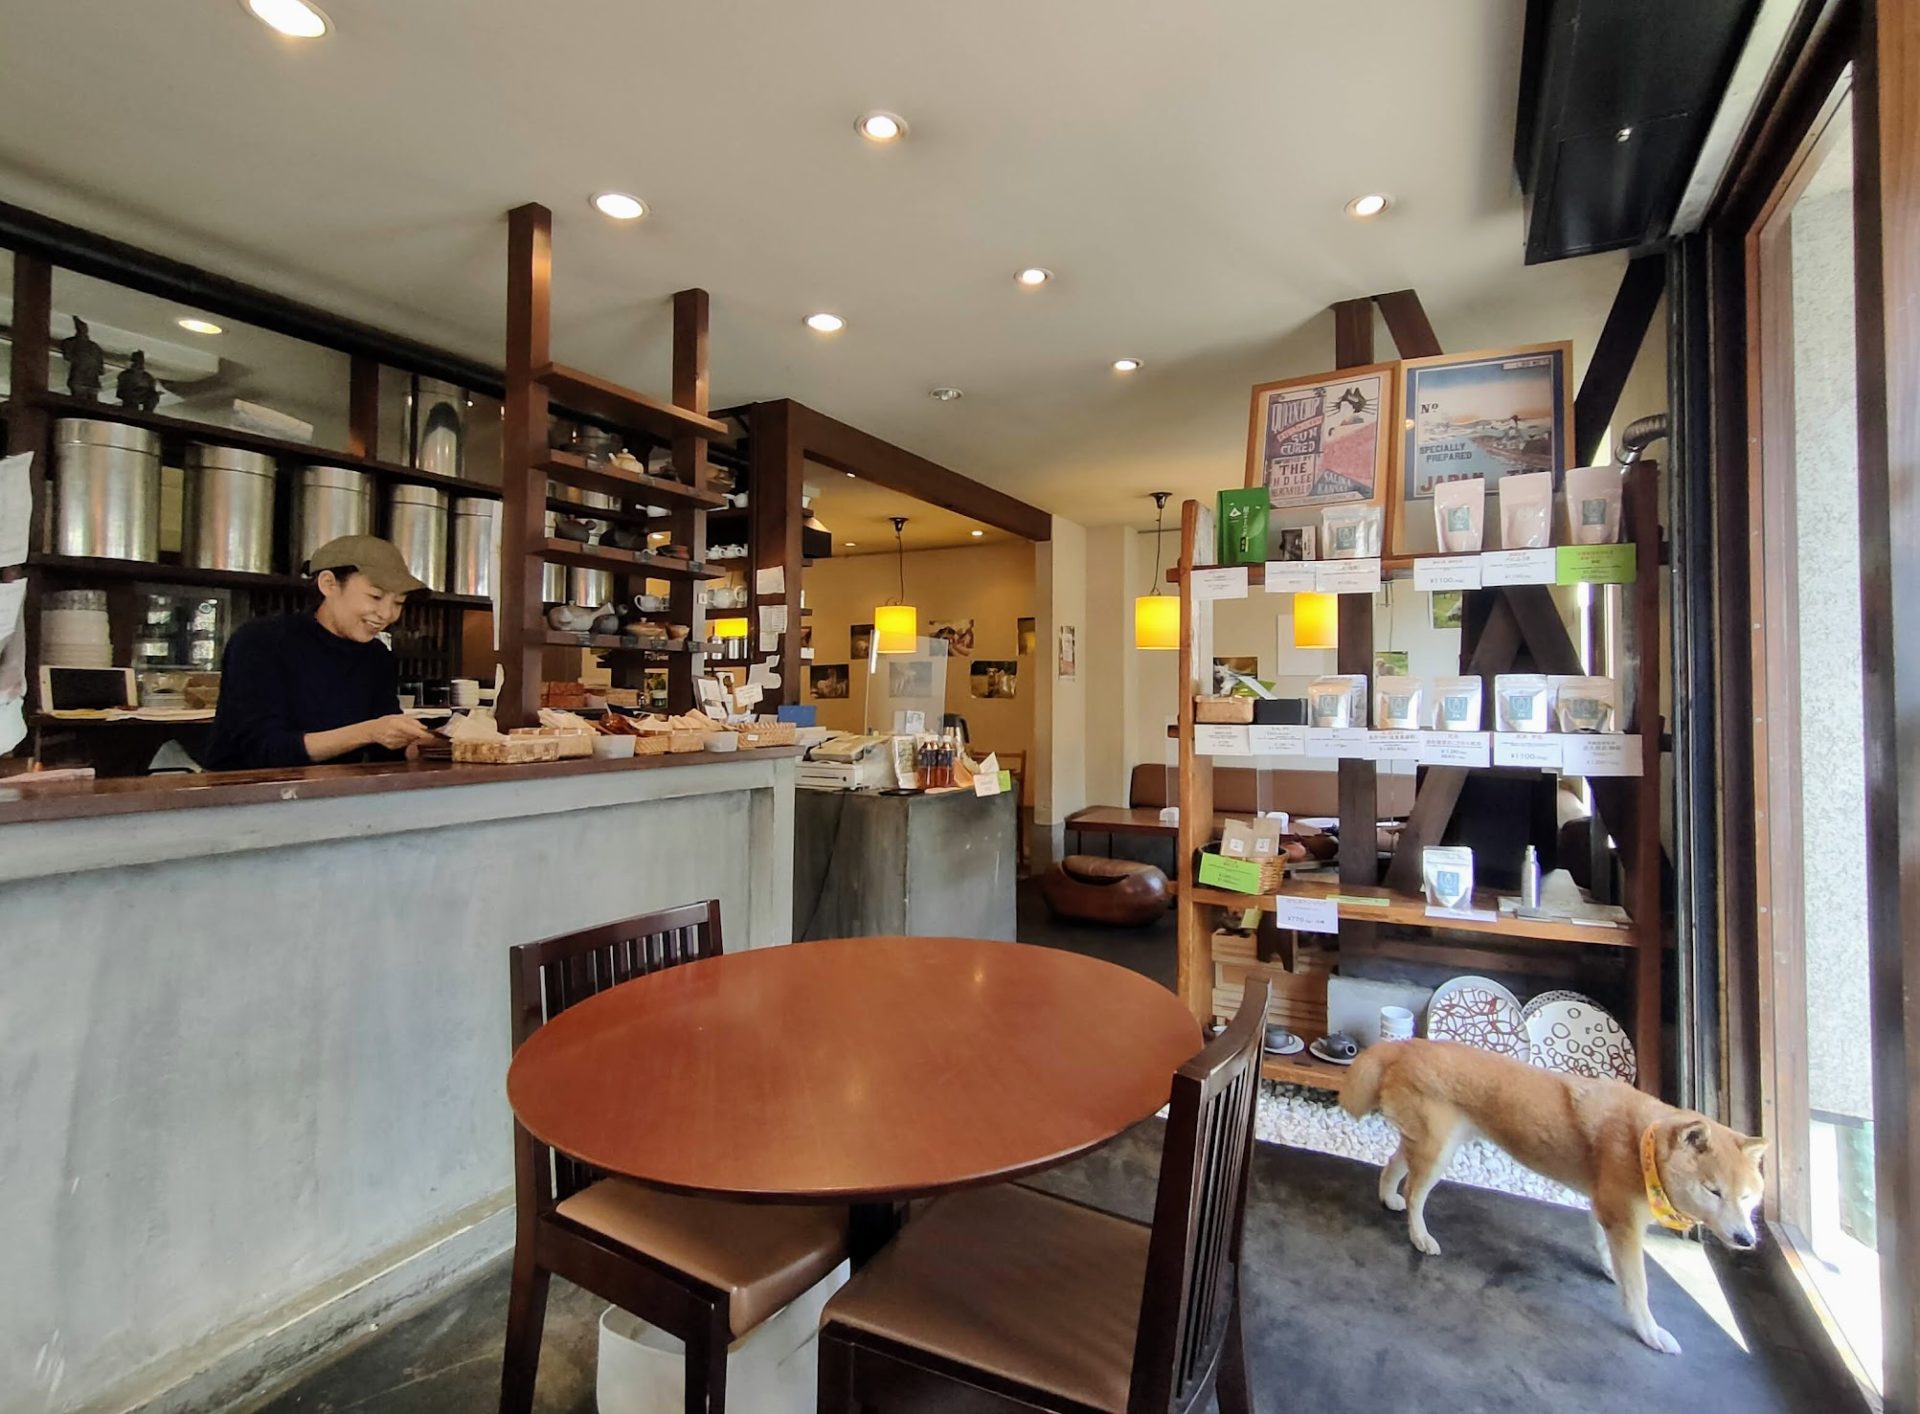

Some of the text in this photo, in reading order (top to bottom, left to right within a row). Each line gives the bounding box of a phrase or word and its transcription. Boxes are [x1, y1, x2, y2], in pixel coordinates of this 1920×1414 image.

[1291, 428, 1318, 443] SUN
[1280, 441, 1316, 455] CURED
[1419, 442, 1466, 455] SPECIALLY
[1426, 451, 1473, 463] PREPARED
[1279, 462, 1307, 475] THE
[1294, 473, 1312, 485] LEE
